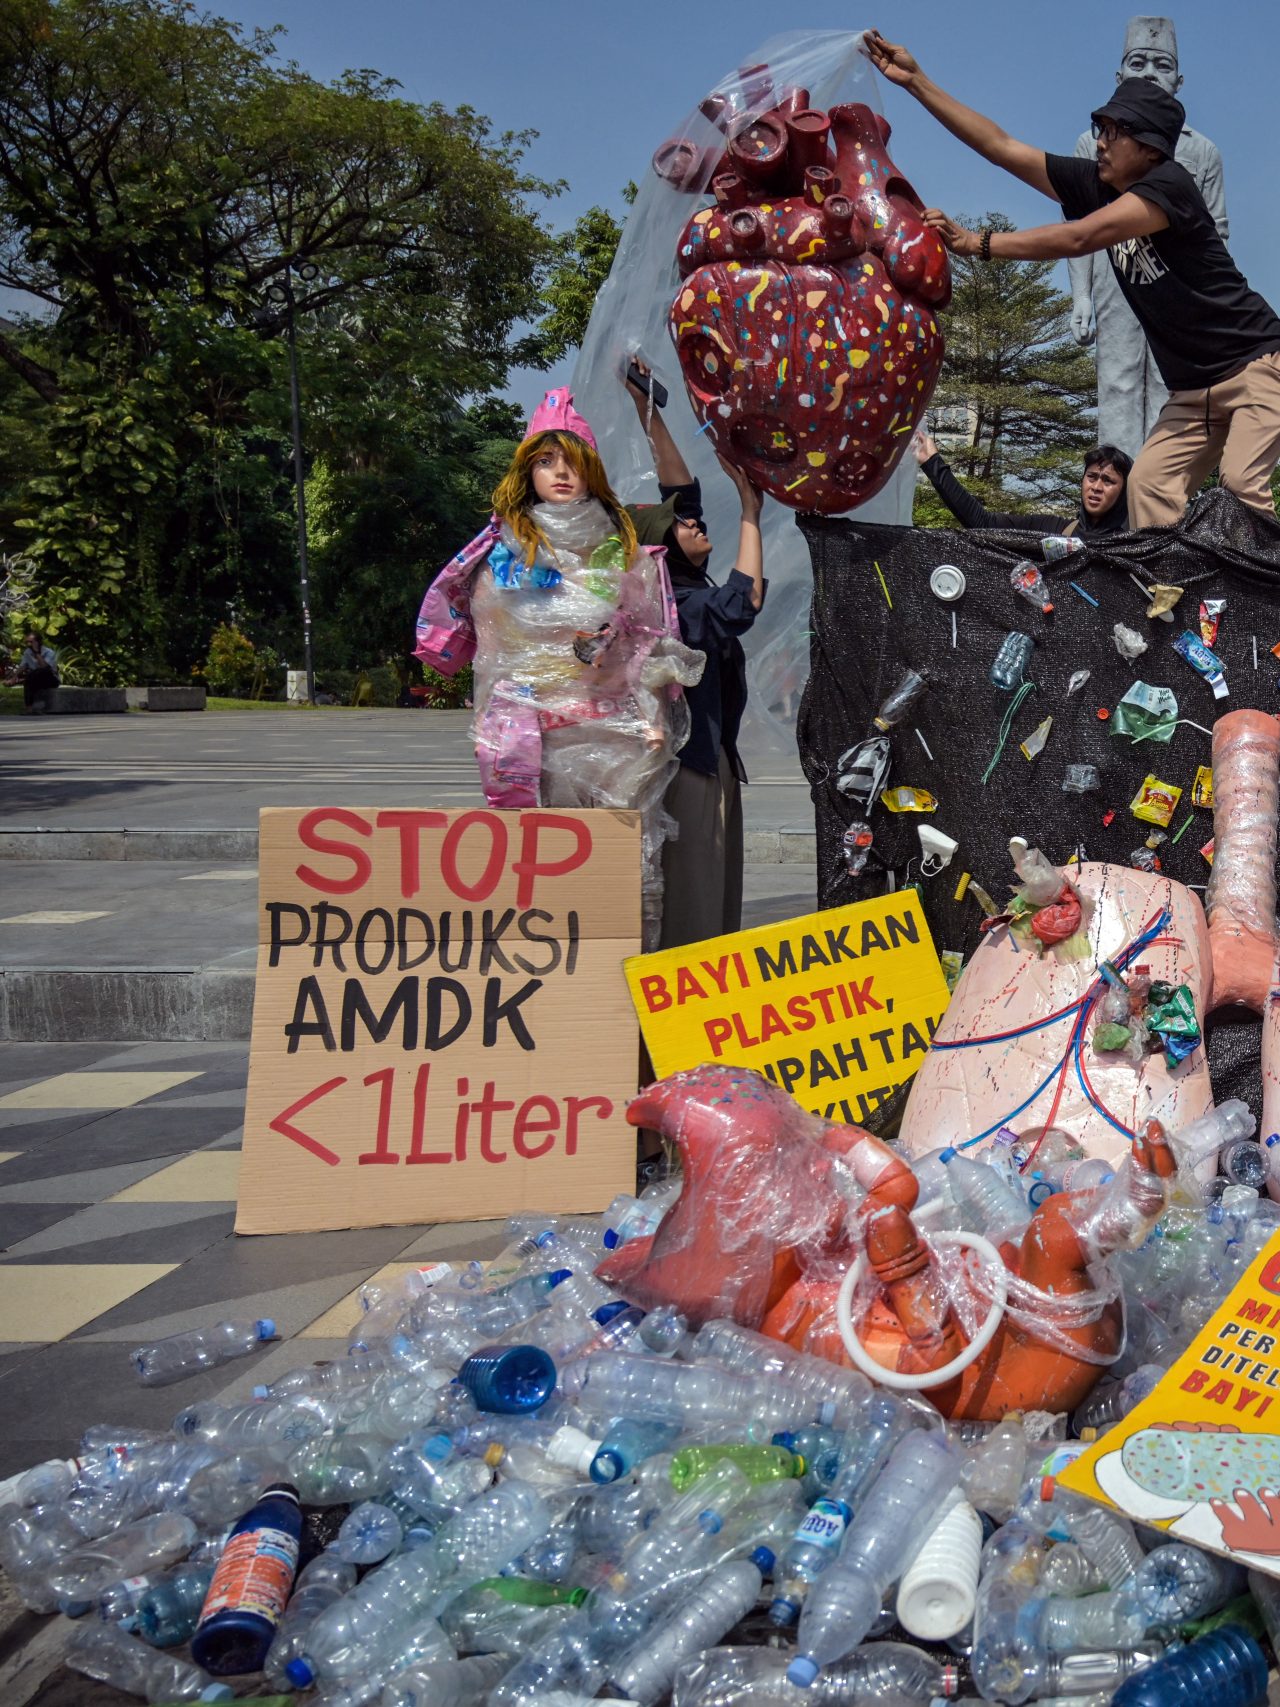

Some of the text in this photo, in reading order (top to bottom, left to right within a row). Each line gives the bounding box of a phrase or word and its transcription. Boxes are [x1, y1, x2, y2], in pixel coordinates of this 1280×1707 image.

[295, 807, 593, 910] STOP
[265, 901, 580, 976] PRODUKSI
[639, 910, 921, 1014] BAYI MAKAN
[285, 975, 544, 1054] AMDK
[1219, 1322, 1278, 1356] PER
[1178, 1370, 1276, 1418] BAYI
